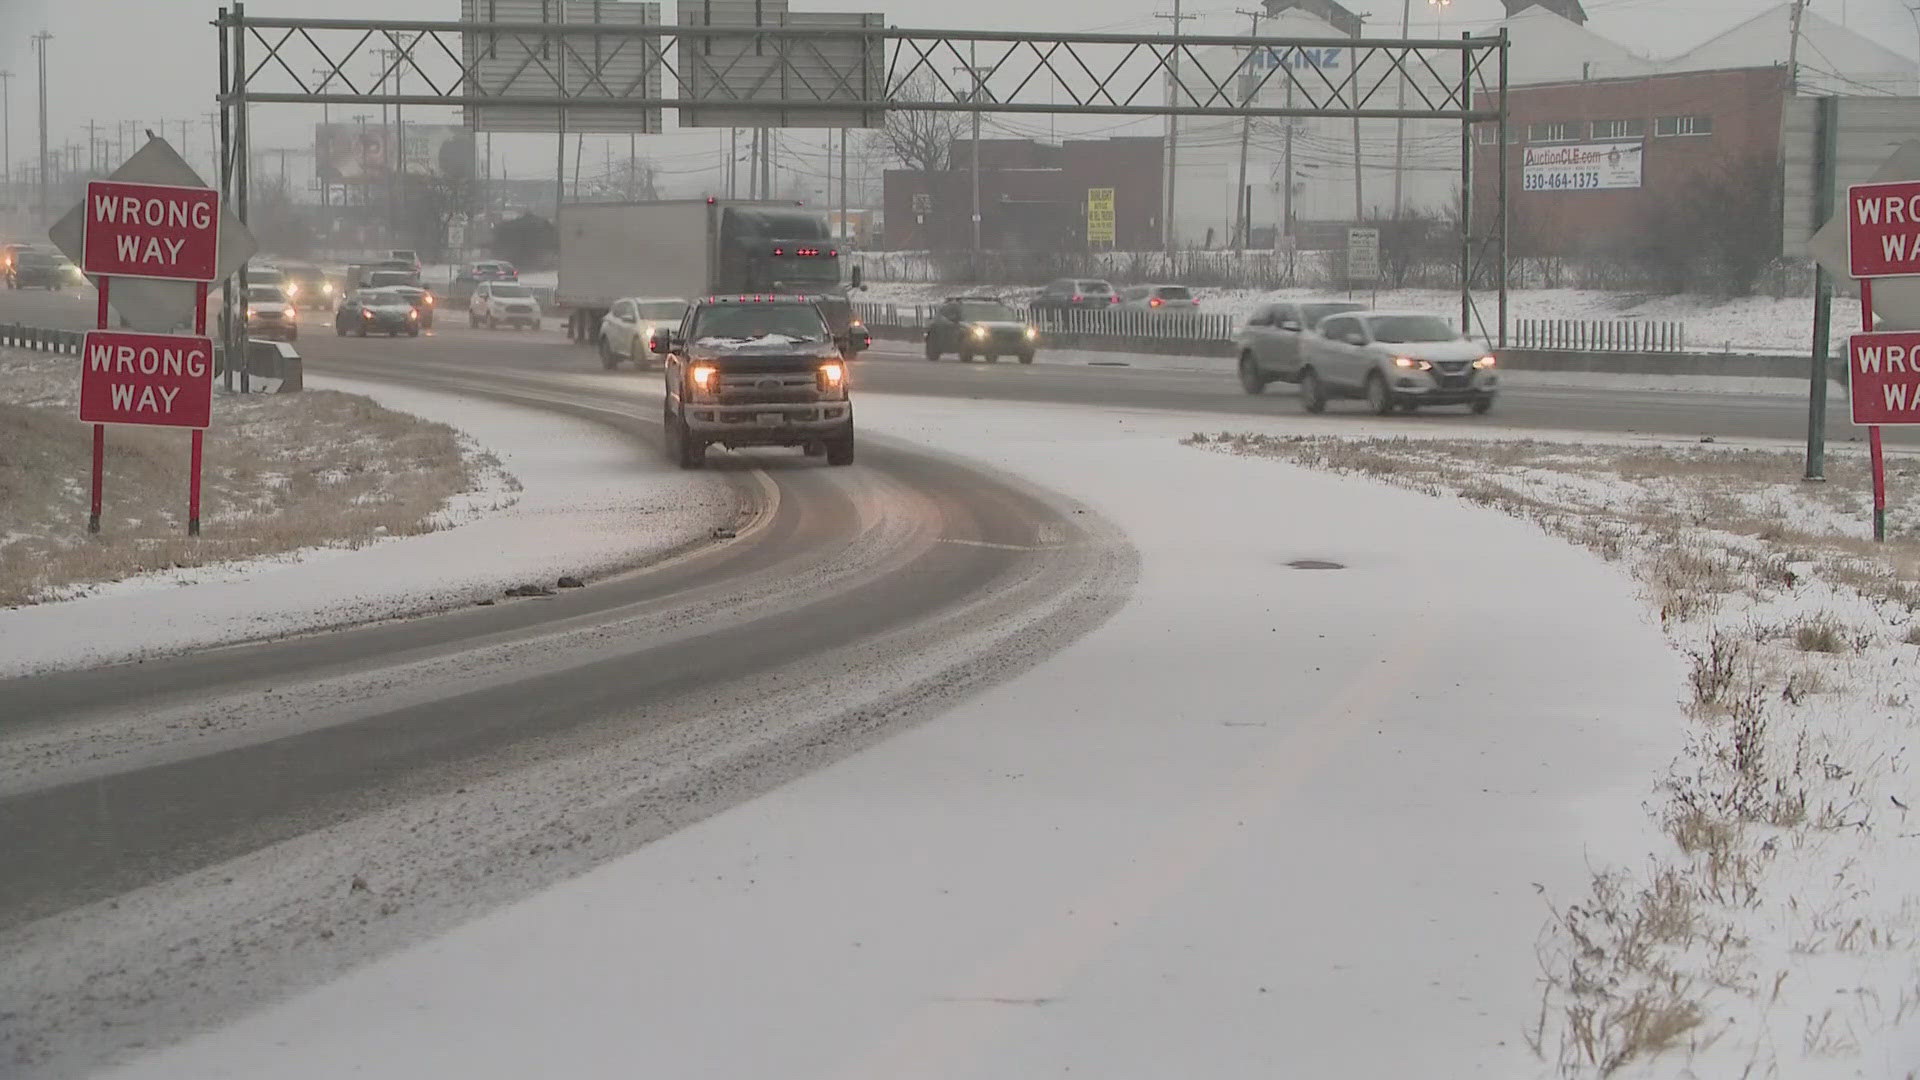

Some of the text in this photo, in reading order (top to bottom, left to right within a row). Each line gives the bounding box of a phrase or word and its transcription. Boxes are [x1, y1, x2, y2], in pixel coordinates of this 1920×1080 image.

[1525, 148, 1600, 165] AuctionCLE.com
[1525, 172, 1599, 189] 330-464-1375
[95, 195, 211, 229] WRONG
[1857, 197, 1920, 225] WRO
[117, 235, 185, 264] WAY
[1881, 235, 1920, 262] WA
[91, 344, 205, 377] WRONG
[1858, 346, 1920, 373] WRO
[111, 383, 180, 414] WAY
[1883, 383, 1920, 411] WA
